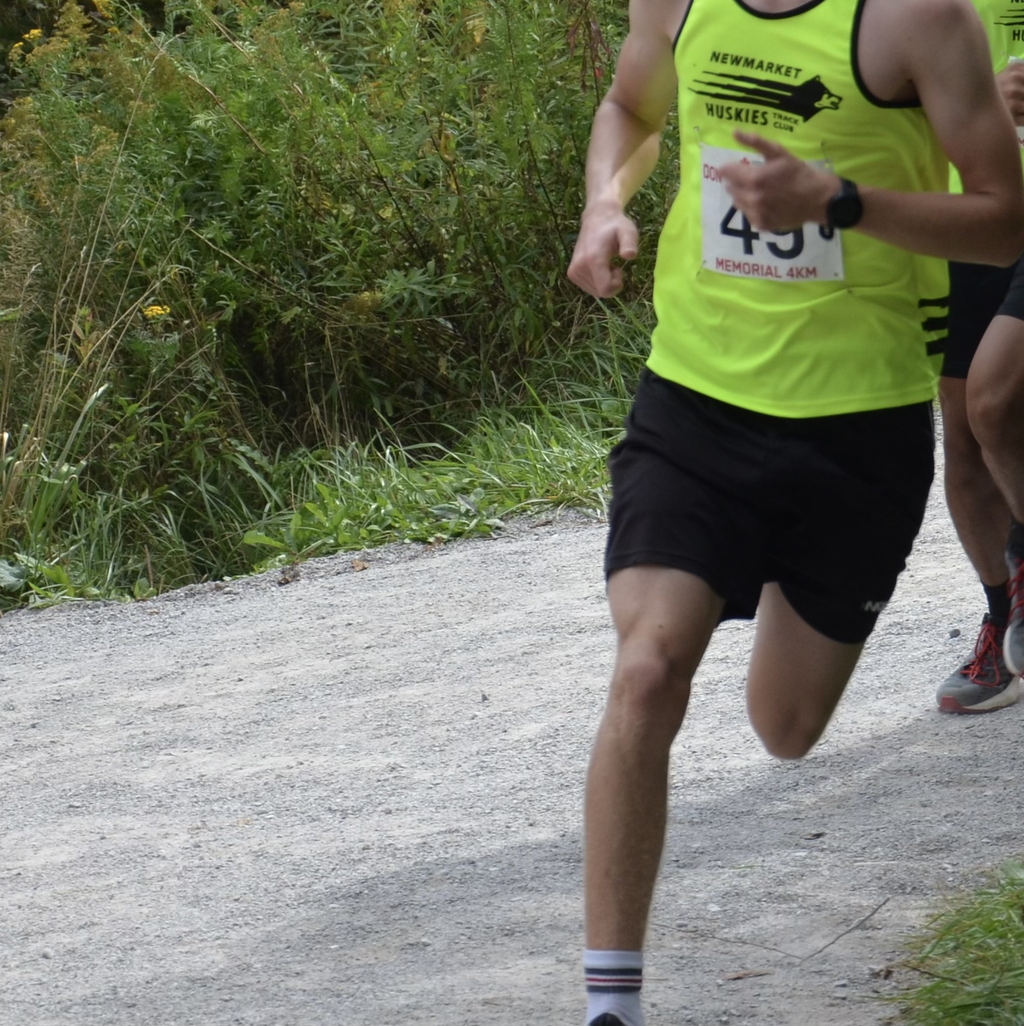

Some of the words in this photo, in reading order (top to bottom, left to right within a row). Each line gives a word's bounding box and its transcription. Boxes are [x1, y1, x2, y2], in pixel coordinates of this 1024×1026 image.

[710, 51, 802, 79] NEWMARKET
[705, 102, 769, 126] HUSKIES
[772, 112, 799, 125] TRACK
[773, 121, 794, 132] CLUB
[715, 257, 782, 278] MEMORIAL
[786, 267, 818, 278] 4KM
